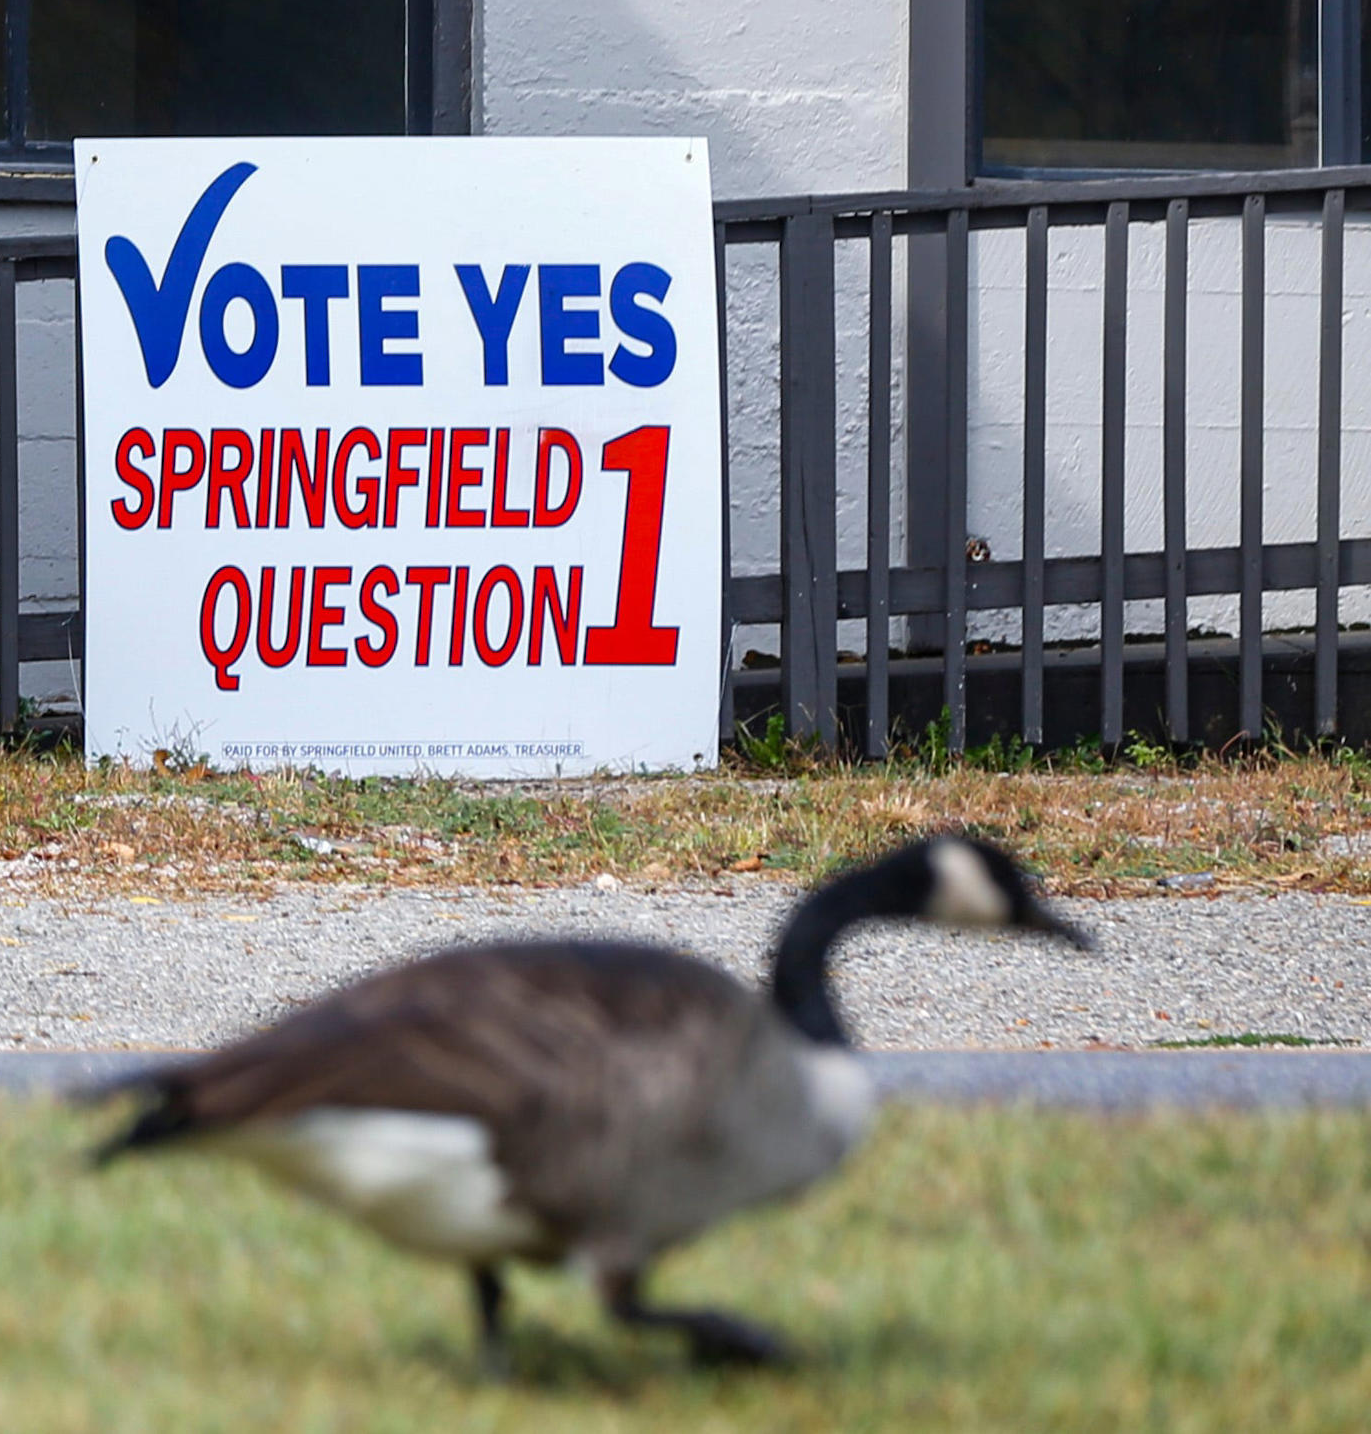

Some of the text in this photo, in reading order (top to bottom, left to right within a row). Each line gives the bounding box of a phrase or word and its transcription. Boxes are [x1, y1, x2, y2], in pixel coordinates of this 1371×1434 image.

[104, 161, 678, 389] VOTE YES
[110, 426, 583, 530] SPRINGFIELD
[199, 424, 680, 692] QUESTION 1
[224, 744, 253, 757] PAID
[255, 744, 279, 757] FOR
[281, 744, 298, 757] BY
[299, 744, 376, 757] SPRINGFIELD
[427, 744, 463, 757] BRETT
[514, 744, 582, 757] TREASURER
